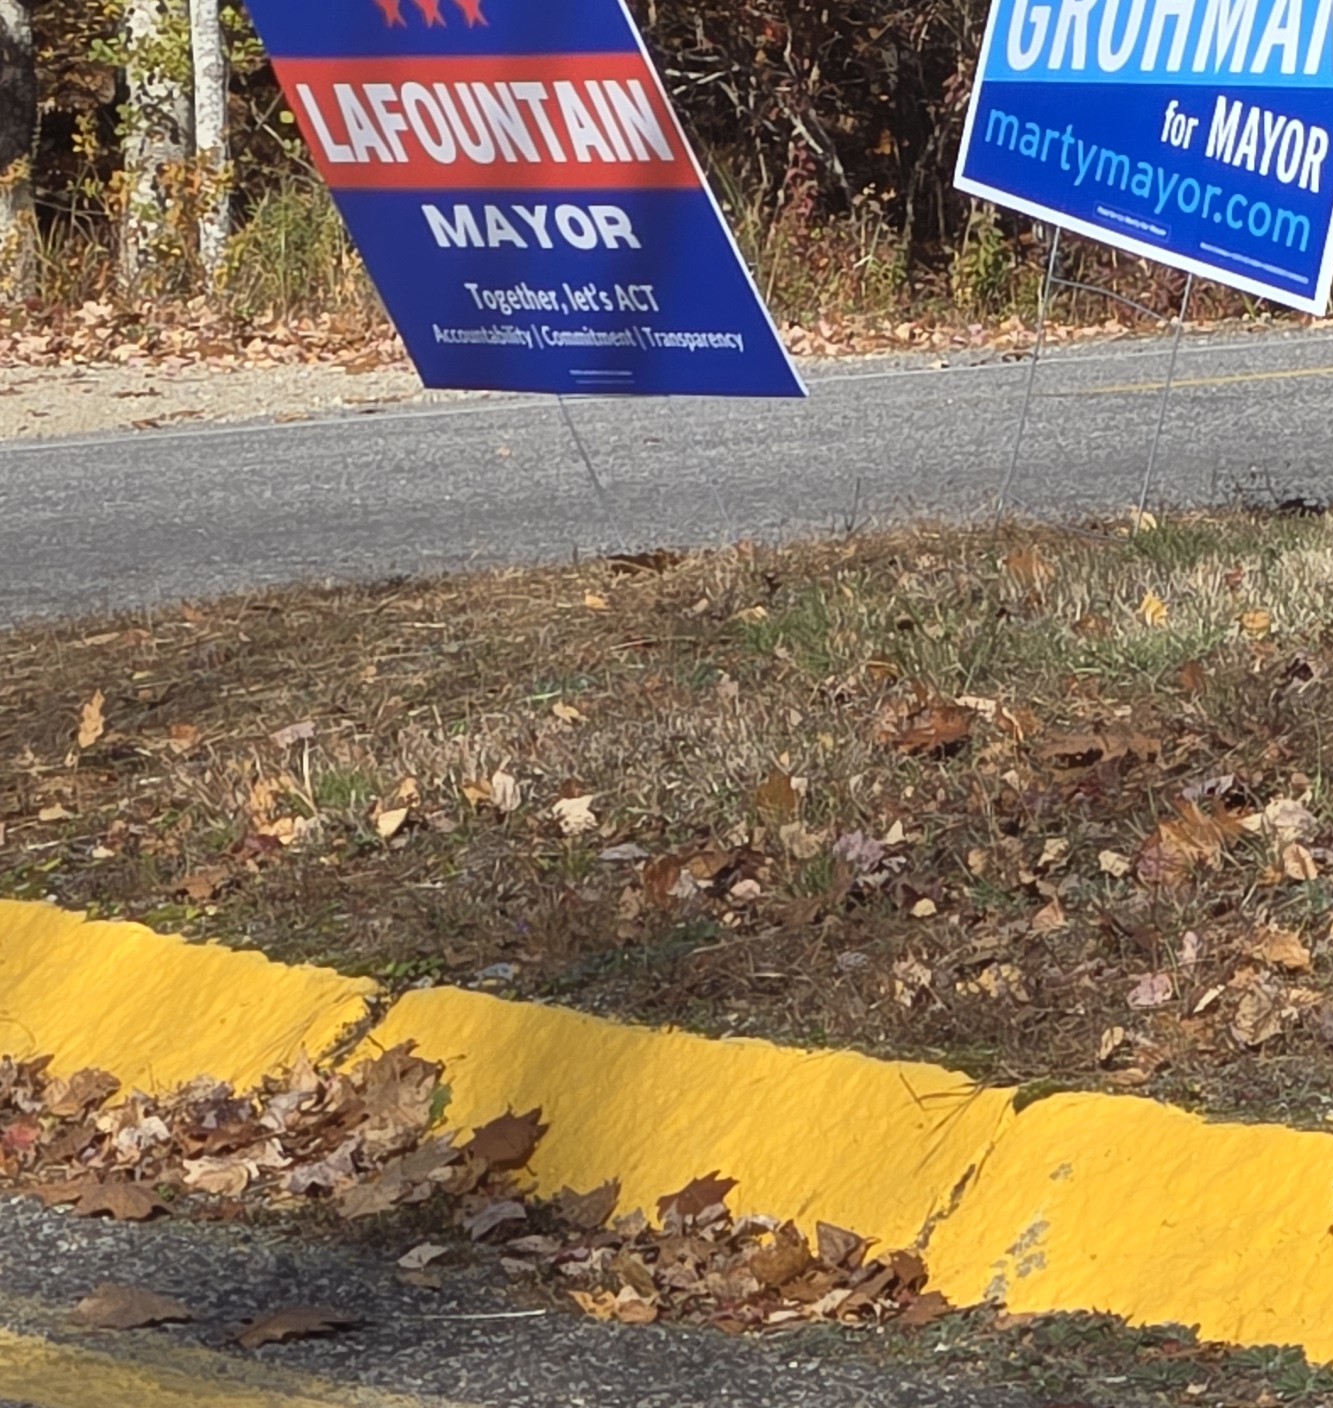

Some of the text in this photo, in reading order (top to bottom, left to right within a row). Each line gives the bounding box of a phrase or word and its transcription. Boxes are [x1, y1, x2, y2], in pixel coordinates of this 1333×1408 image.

[296, 79, 674, 164] LAFOUNTAIN
[1161, 95, 1329, 193] for MAYOR
[984, 108, 1310, 252] martymayor.com
[421, 204, 642, 250] MAYOR
[464, 282, 660, 315] Together, let's ACT
[432, 324, 533, 349] Accountability
[541, 326, 636, 347] Commitment
[641, 327, 744, 352] Transparency
